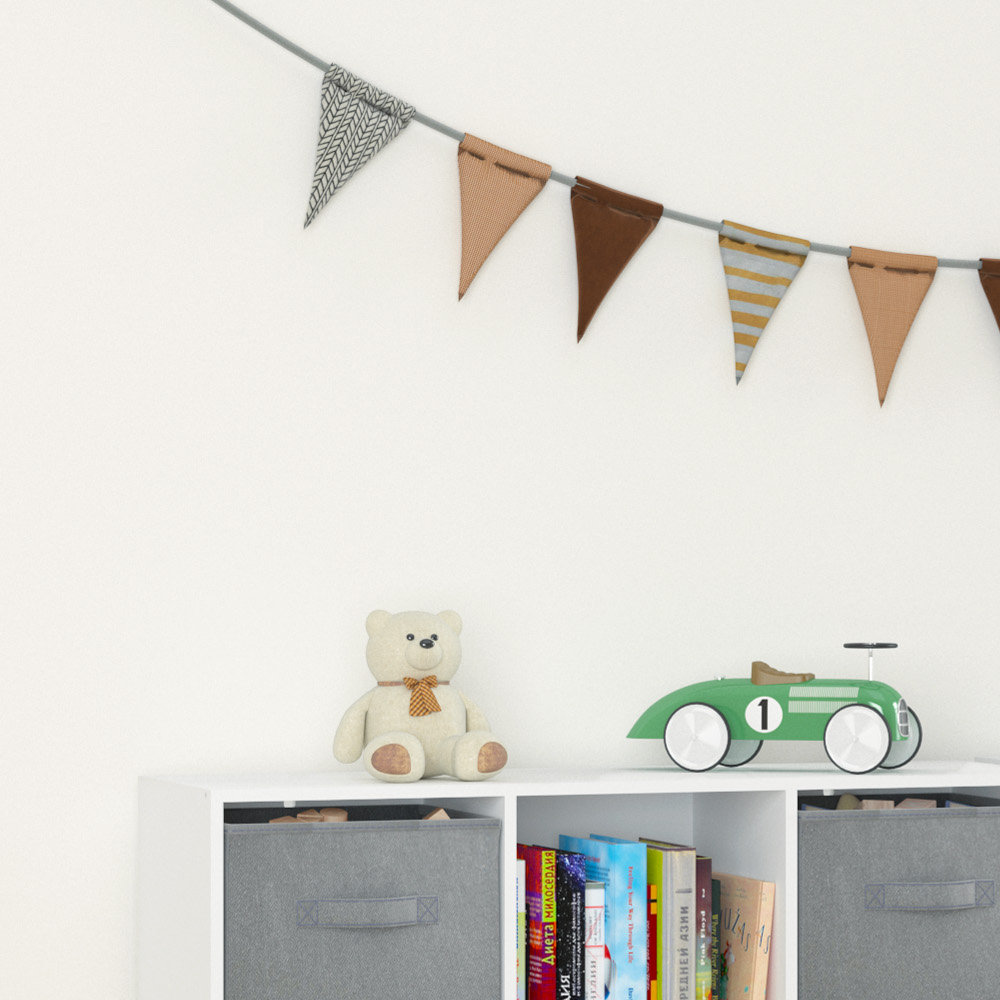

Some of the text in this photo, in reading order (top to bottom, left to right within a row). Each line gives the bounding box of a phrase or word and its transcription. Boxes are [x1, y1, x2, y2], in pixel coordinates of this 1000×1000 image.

[758, 699, 769, 730] 1
[542, 852, 556, 966] Диета милосердия
[679, 906, 689, 941] АЗИИ
